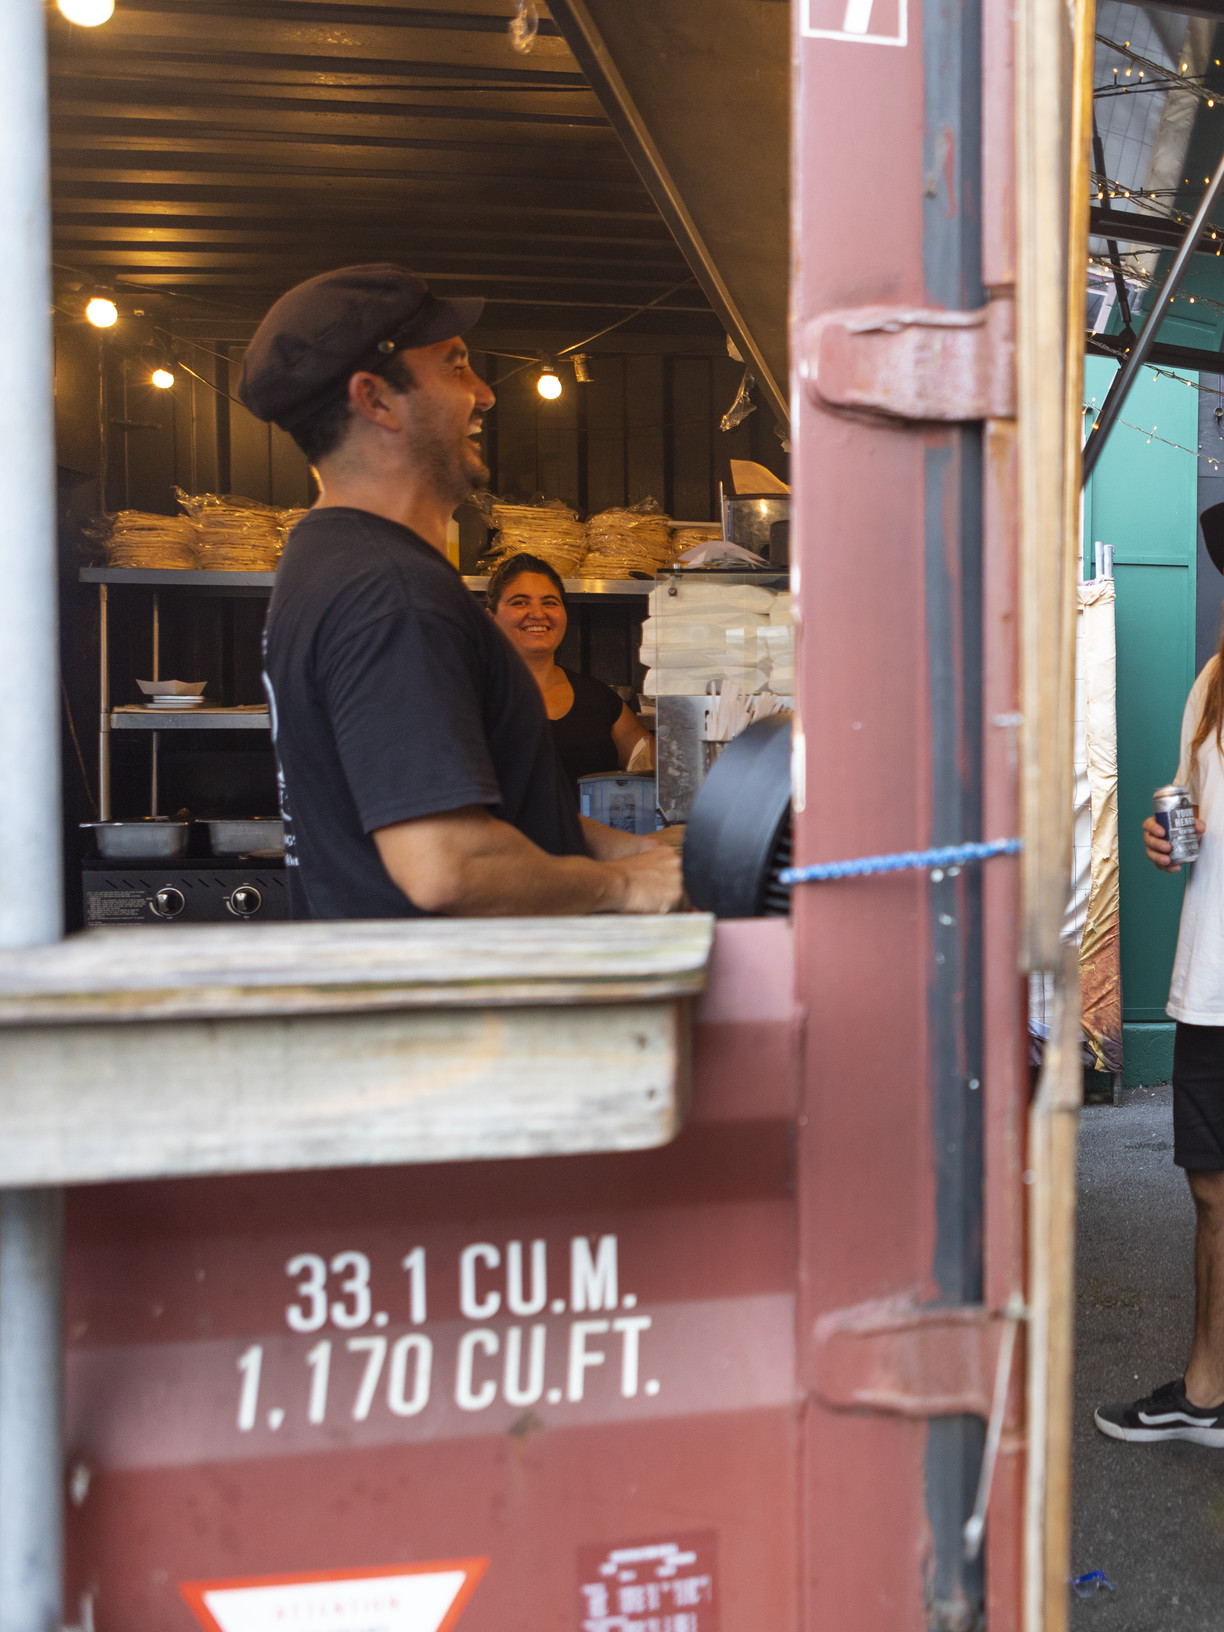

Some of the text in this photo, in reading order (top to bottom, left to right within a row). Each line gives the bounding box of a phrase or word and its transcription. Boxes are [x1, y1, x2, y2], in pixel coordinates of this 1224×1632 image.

[286, 1234, 638, 1332] 33.1 CU.M.
[455, 1315, 661, 1411] CU.FT.
